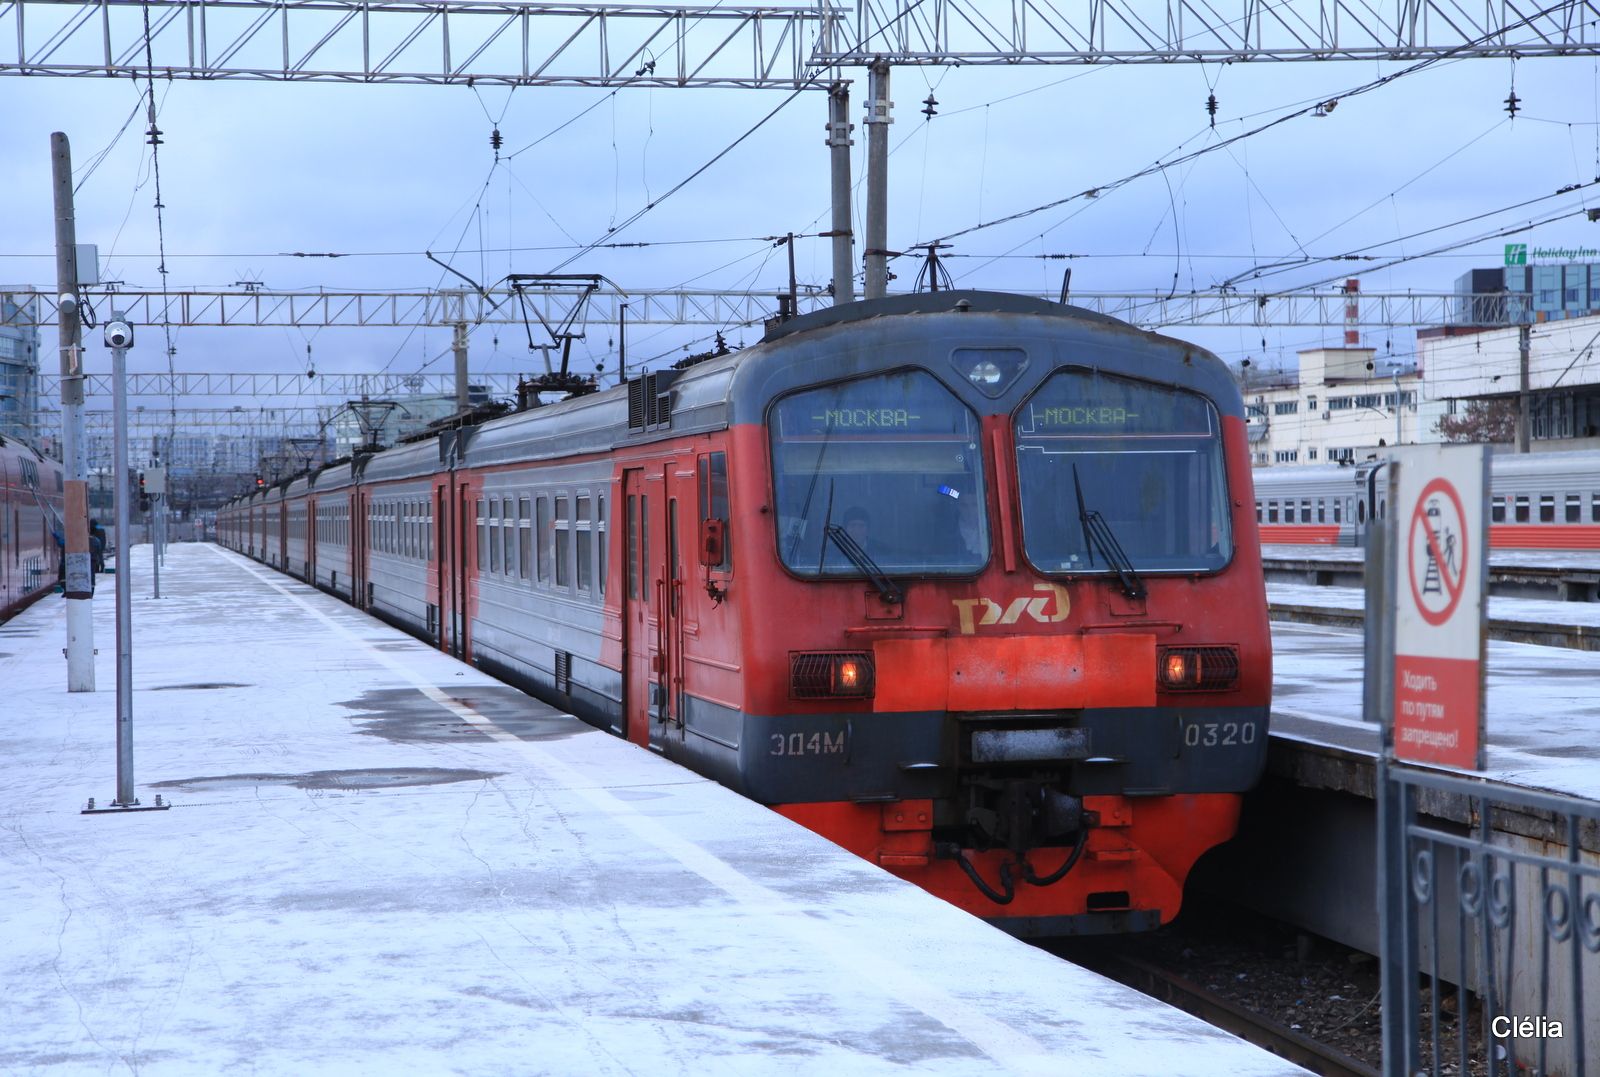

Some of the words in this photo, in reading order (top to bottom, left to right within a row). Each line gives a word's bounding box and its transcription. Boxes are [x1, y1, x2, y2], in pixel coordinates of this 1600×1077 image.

[1532, 247, 1577, 260] Holiday
[1578, 245, 1598, 257] Inn
[1403, 670, 1438, 692] Ходить
[1402, 701, 1415, 716] по
[1416, 702, 1445, 722] путям
[770, 731, 844, 756] ЭД4М
[1185, 722, 1256, 747] 0320
[1402, 727, 1459, 749] запрещено!
